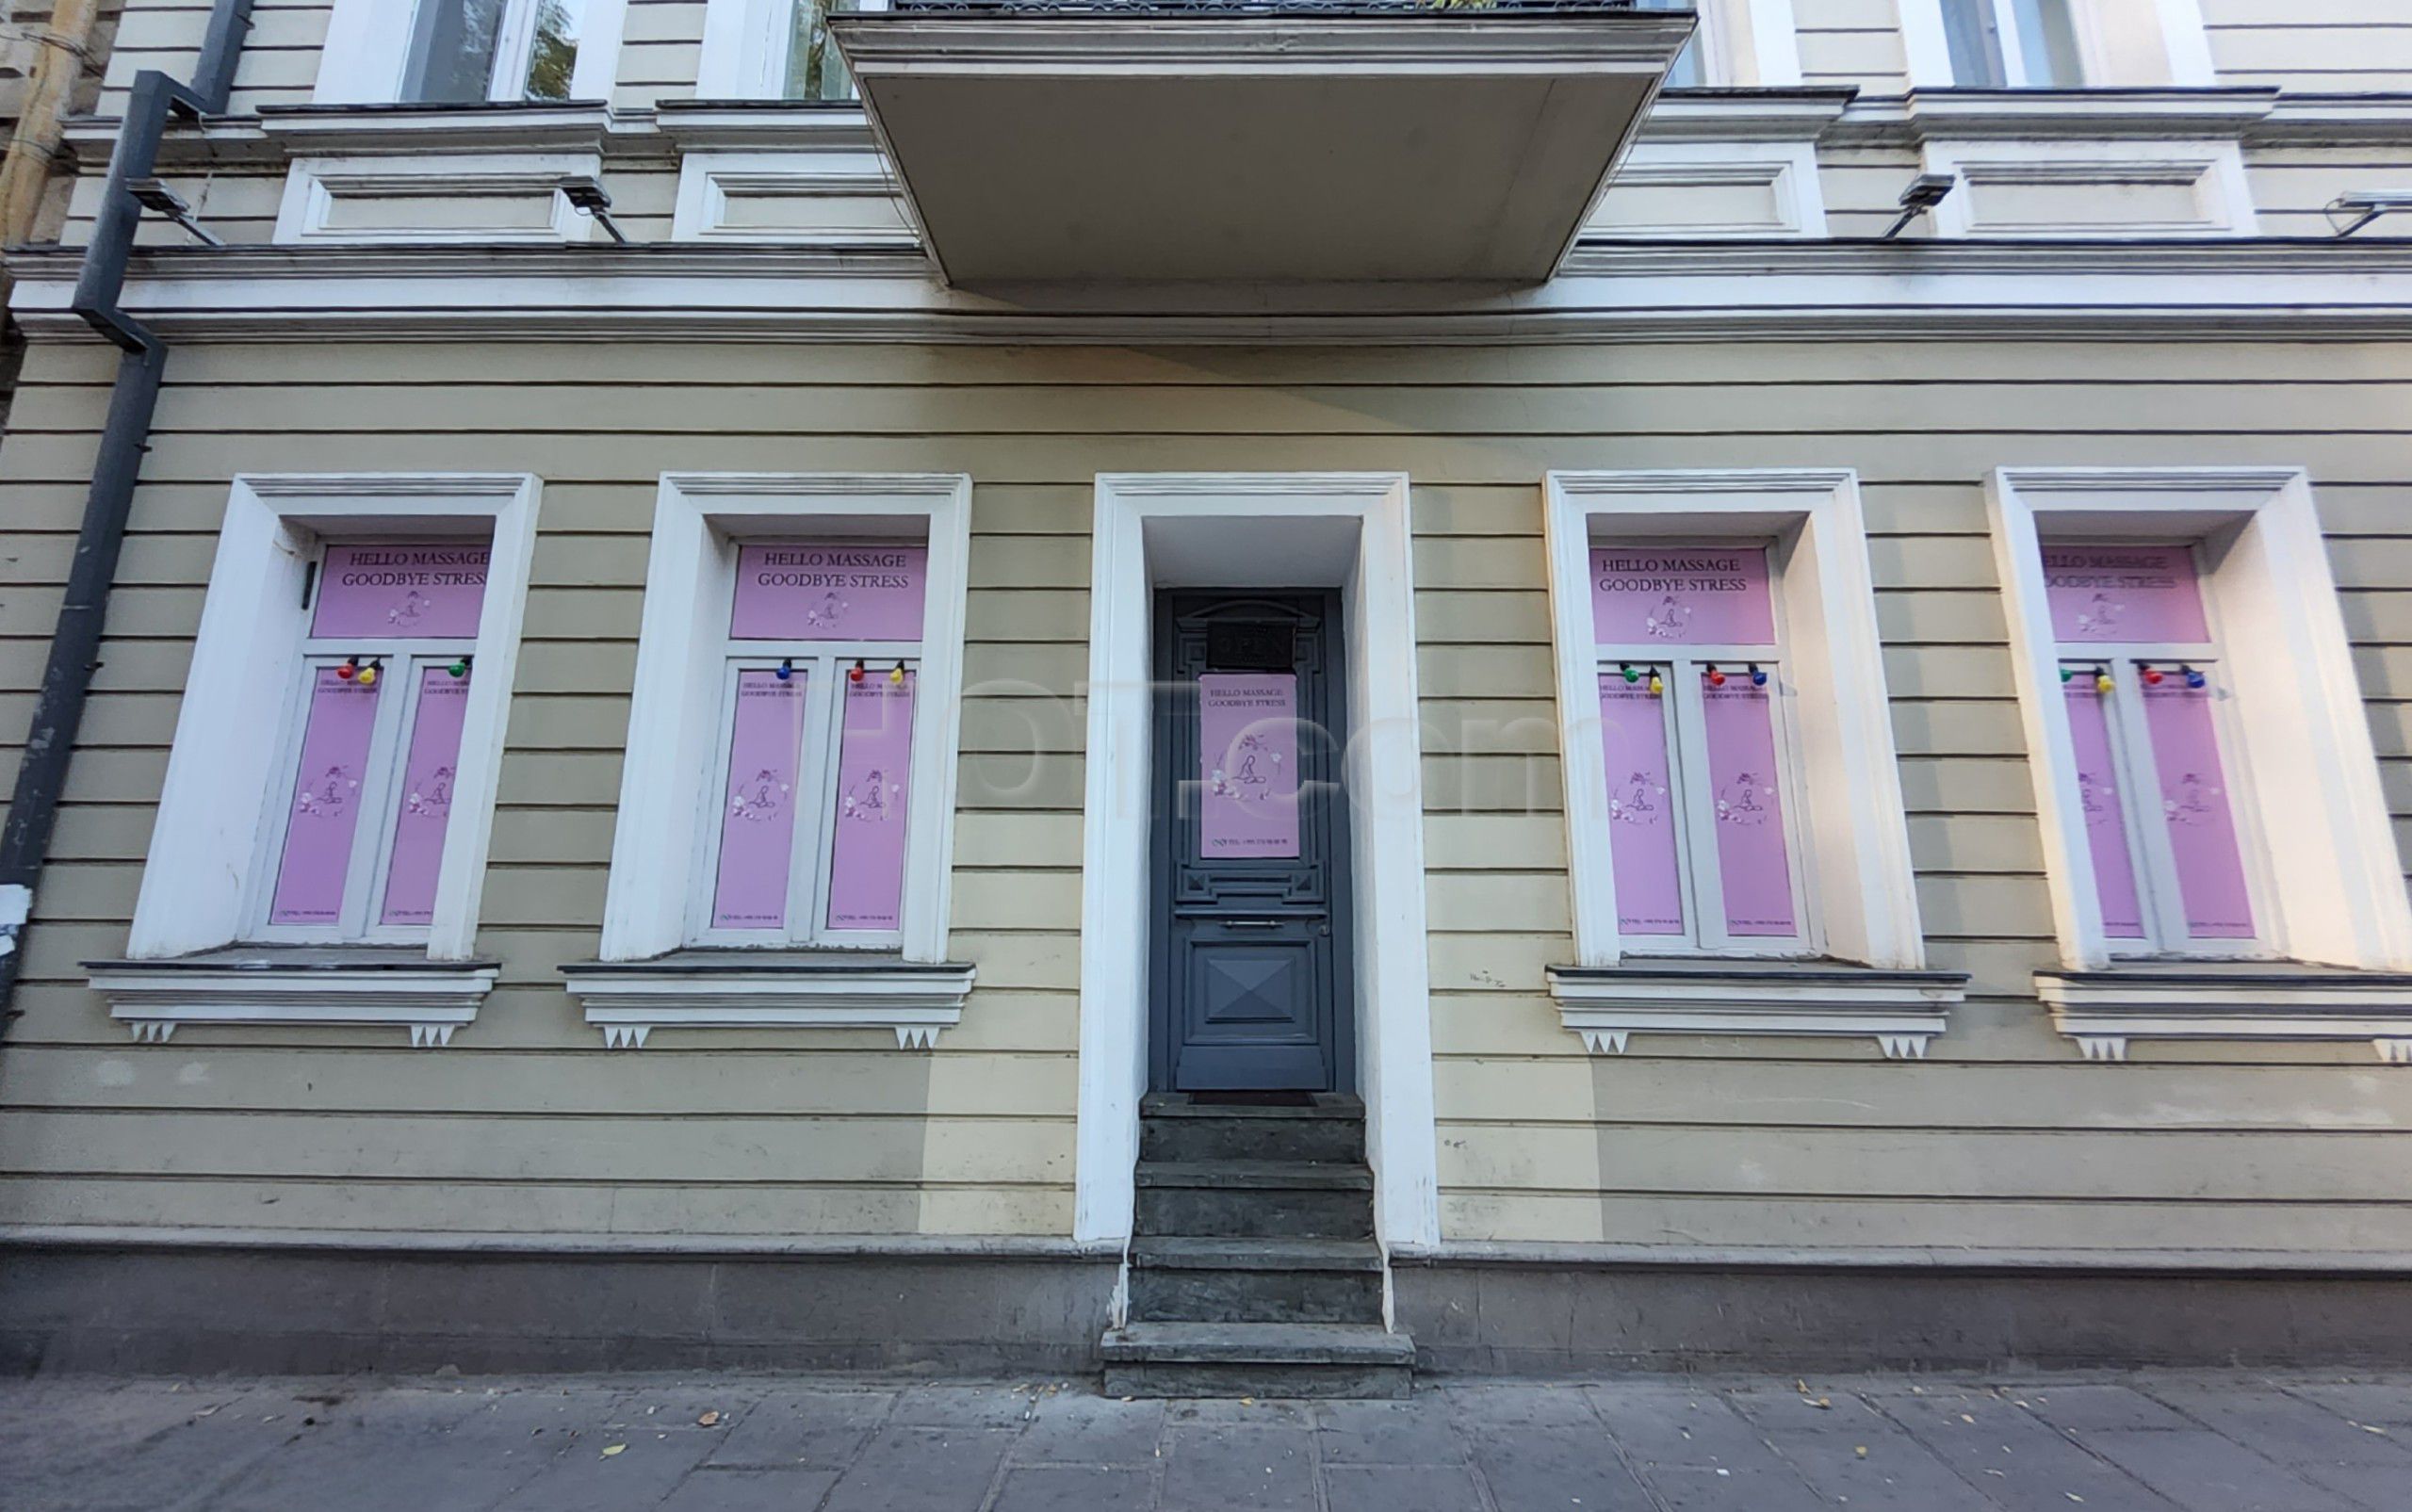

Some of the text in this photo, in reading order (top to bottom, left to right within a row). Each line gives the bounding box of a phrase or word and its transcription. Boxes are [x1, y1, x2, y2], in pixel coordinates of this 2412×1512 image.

[350, 551, 489, 566] HELLO MASSAGE
[764, 552, 906, 567] HELLO MASSAGE
[1603, 559, 1741, 572] HELLO MASSAGE
[342, 572, 486, 586] GOODBYE STRES
[758, 573, 909, 588] GOODBYE STRESS
[1600, 577, 1747, 592] GOODBYE STRESS
[1210, 689, 1284, 697] HELLO MASSAGE
[1208, 699, 1286, 707] GOODBYE STRESS
